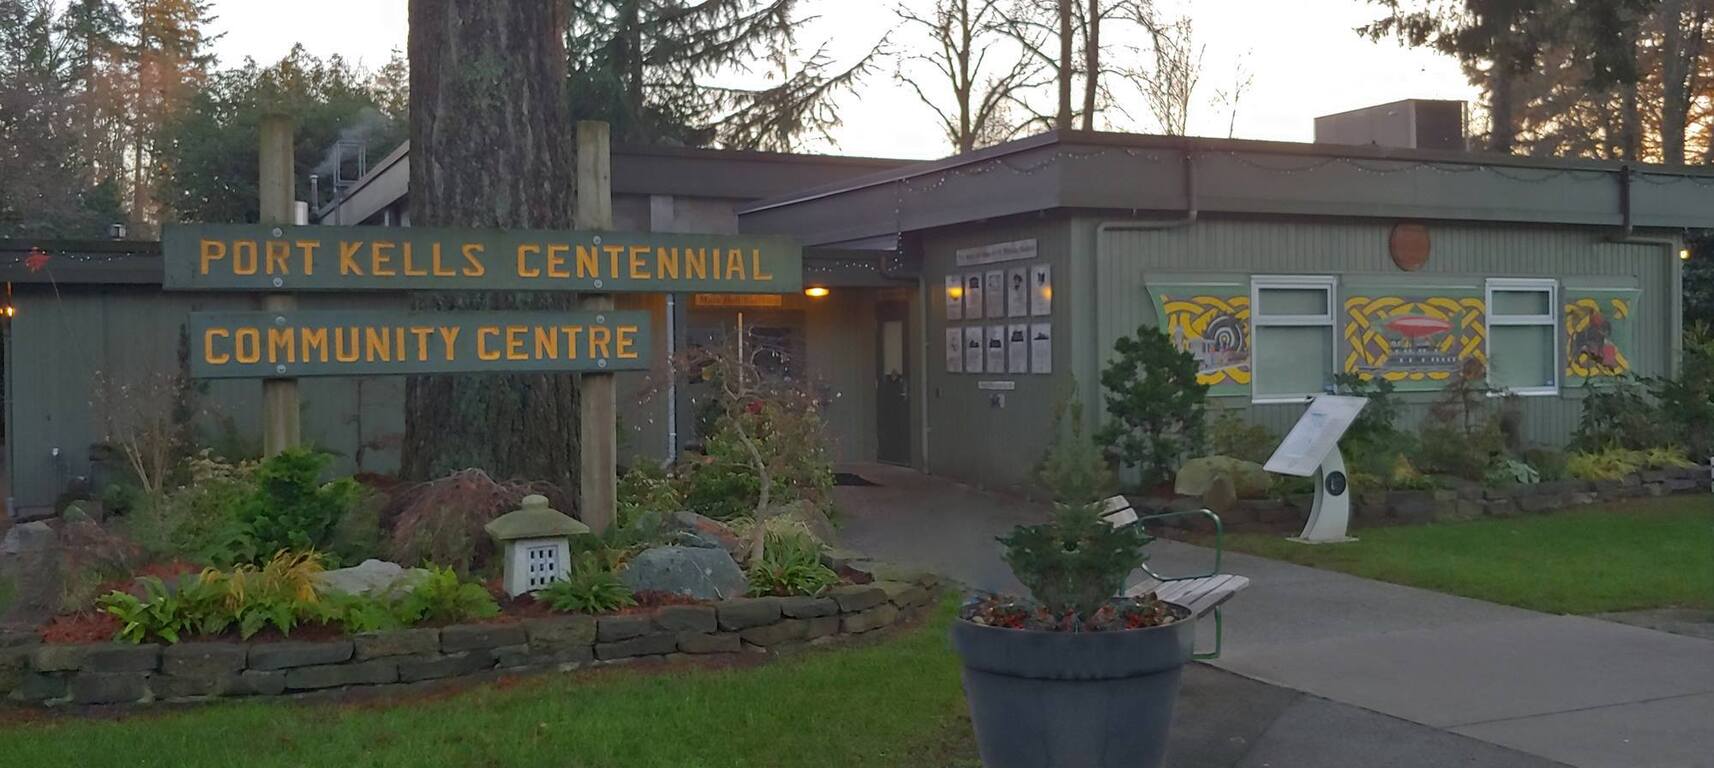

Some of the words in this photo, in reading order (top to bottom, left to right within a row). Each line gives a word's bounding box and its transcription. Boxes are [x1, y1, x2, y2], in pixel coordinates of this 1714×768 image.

[200, 239, 320, 274] PORT
[340, 242, 485, 277] KELLS
[516, 243, 775, 281] CENTENNIAL
[204, 325, 460, 364] COMMUNITY
[475, 324, 640, 361] CENTRE
